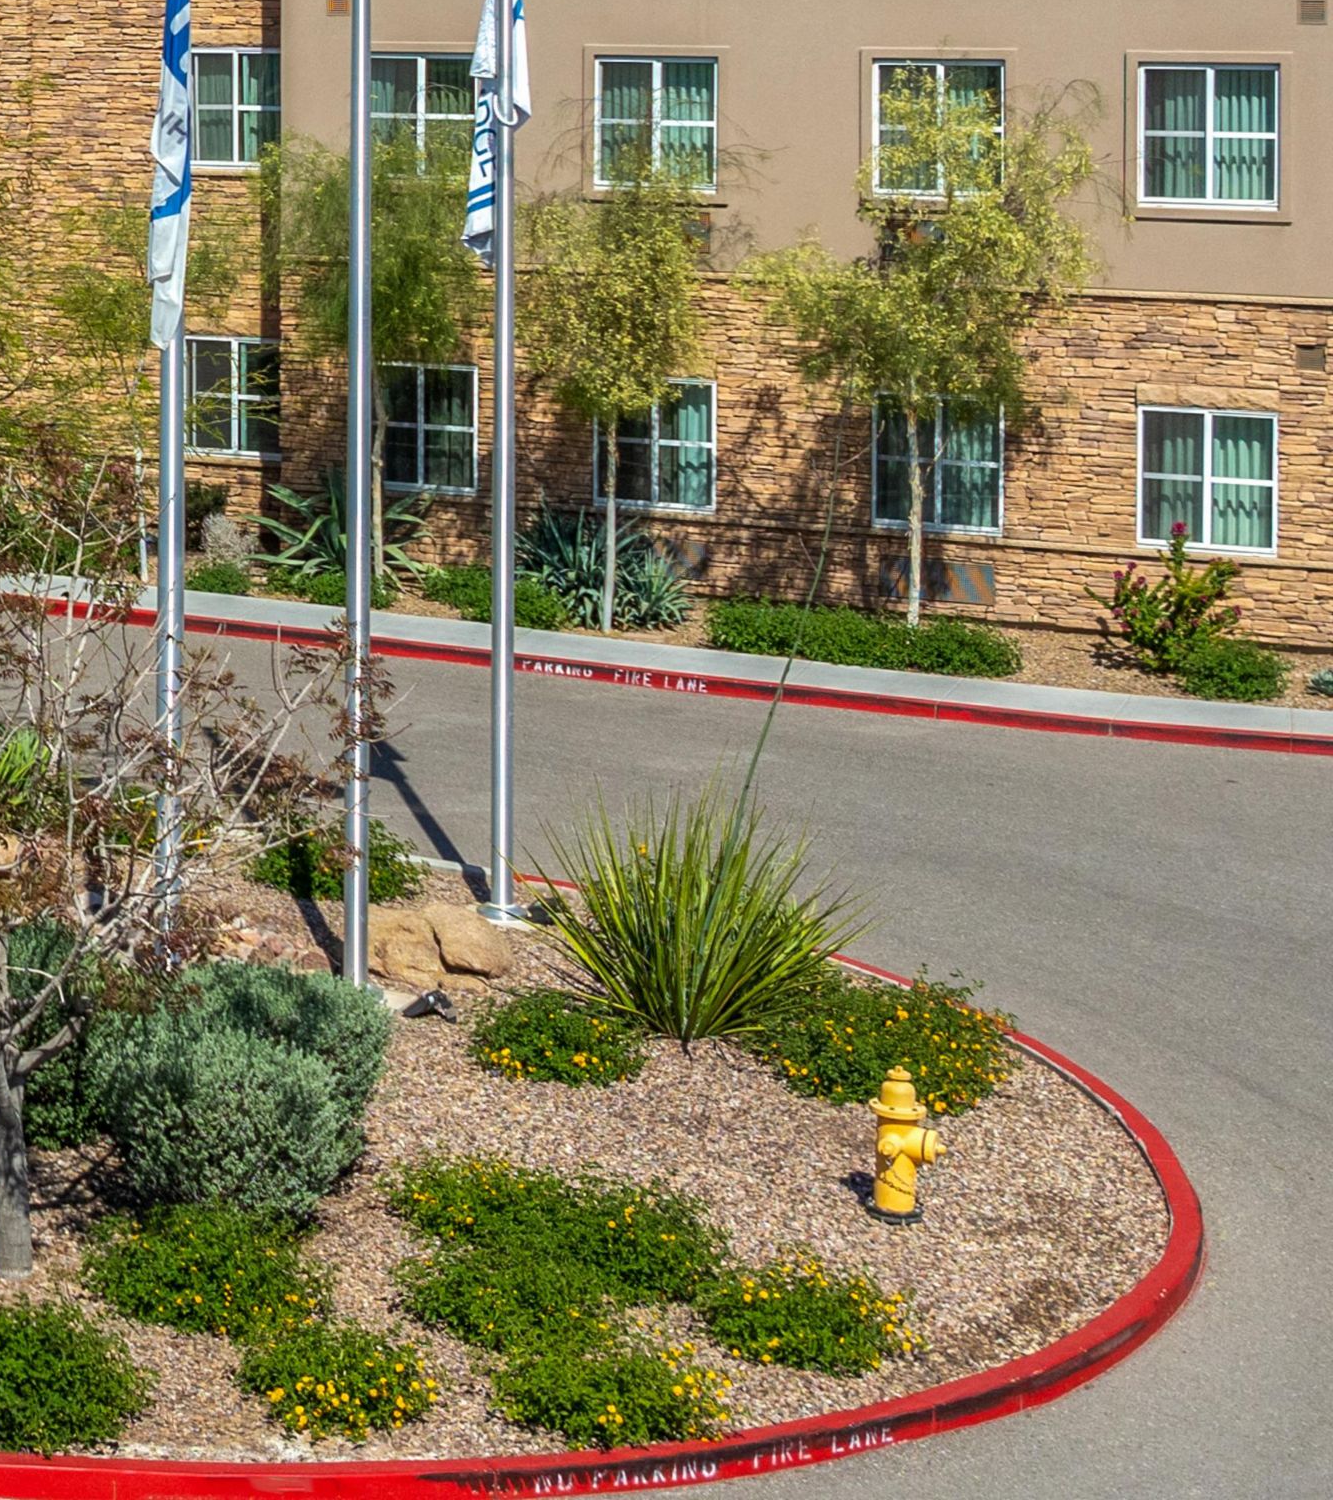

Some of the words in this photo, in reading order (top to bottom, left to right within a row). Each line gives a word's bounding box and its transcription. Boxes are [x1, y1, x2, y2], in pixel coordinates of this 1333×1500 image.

[614, 668, 653, 688] FIRE
[664, 675, 709, 694] LANE
[753, 1438, 812, 1470] FIRE
[832, 1426, 894, 1453] LANE
